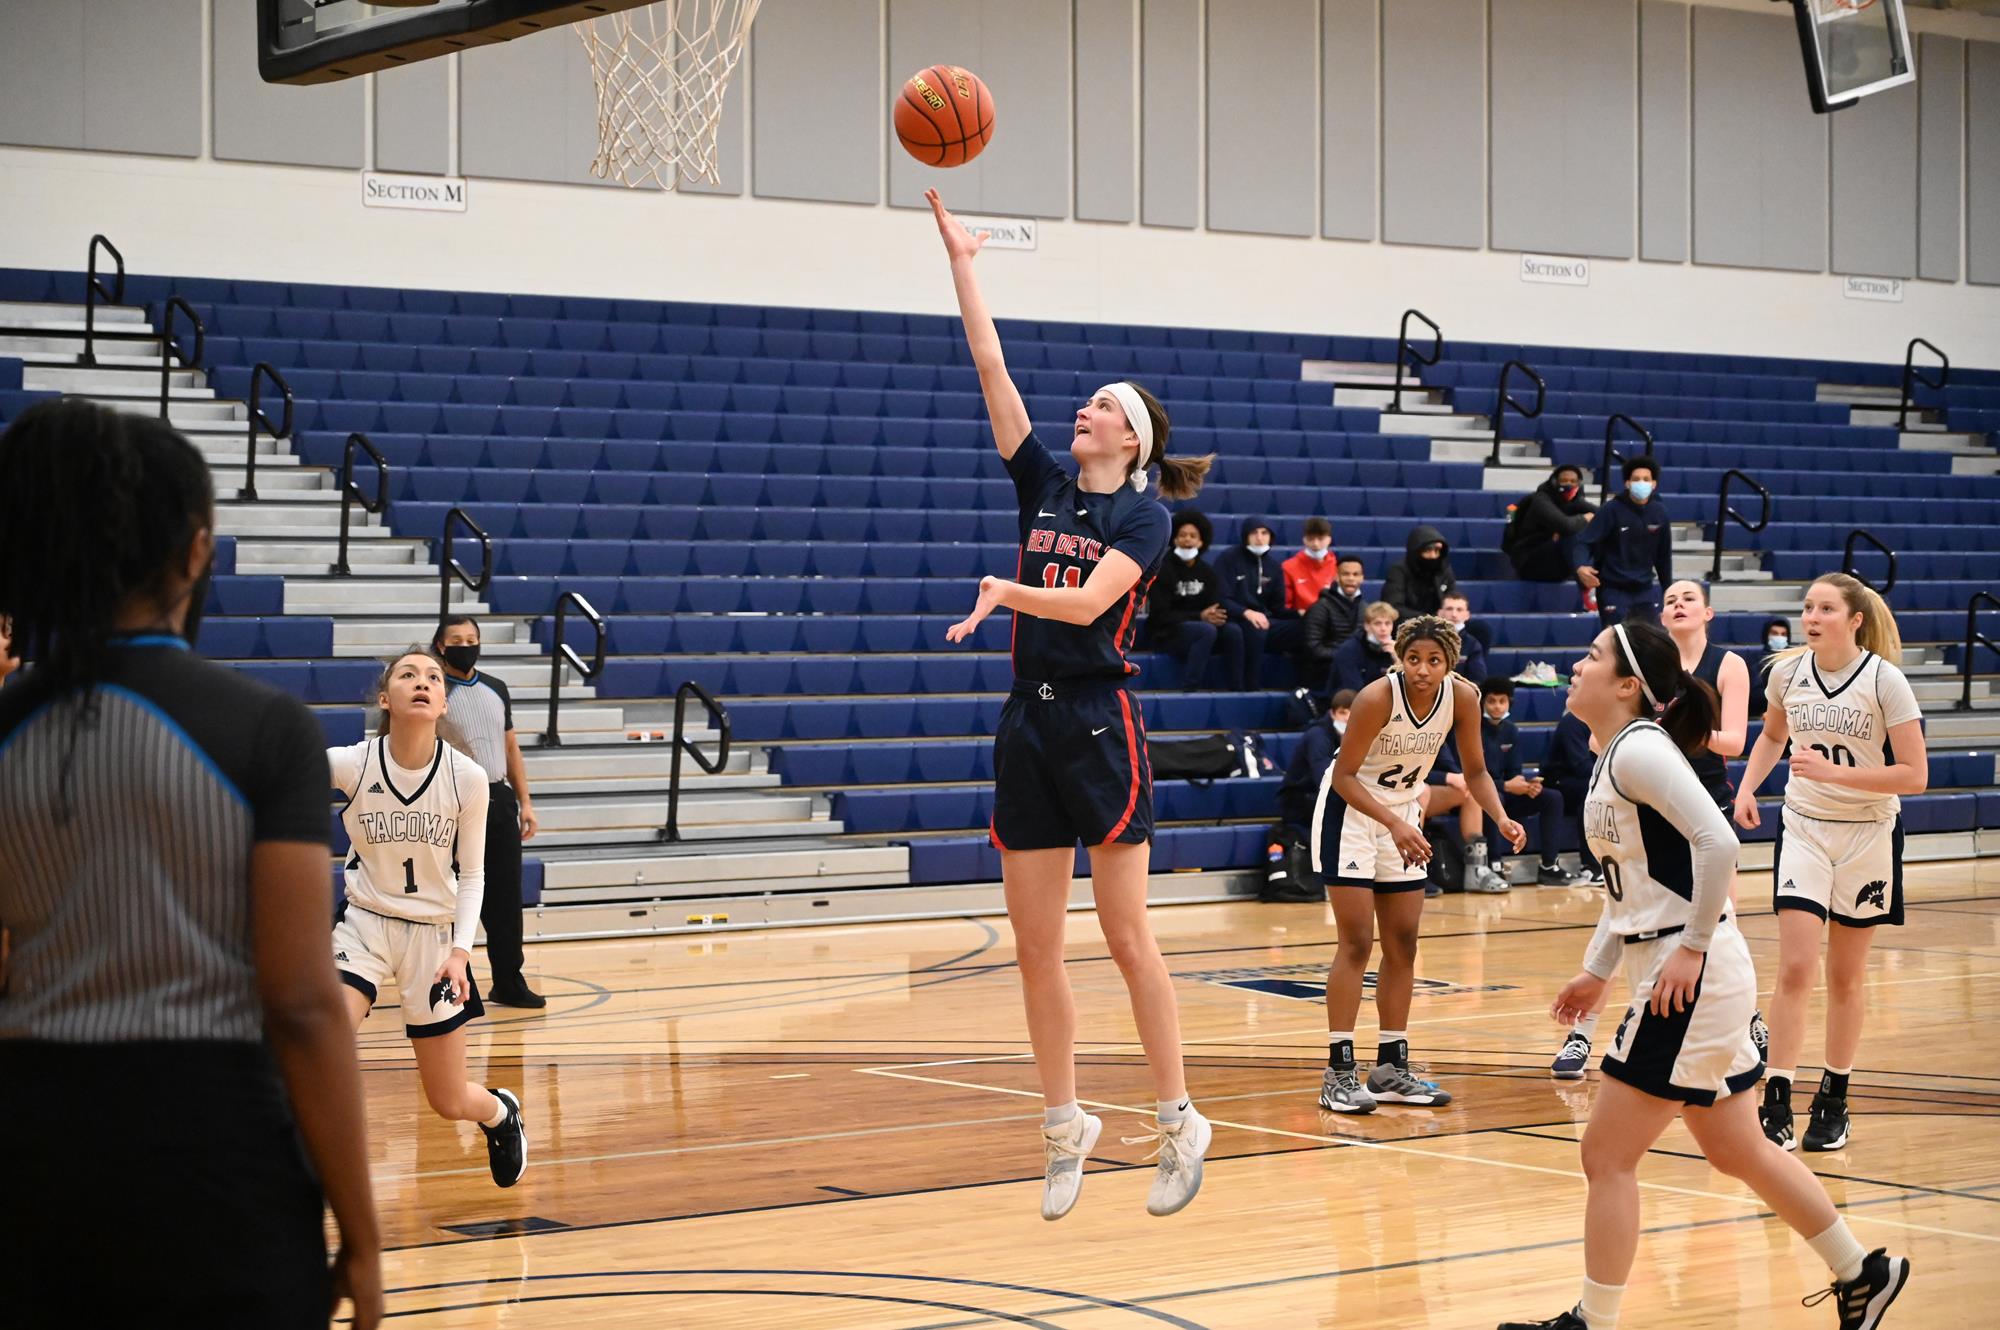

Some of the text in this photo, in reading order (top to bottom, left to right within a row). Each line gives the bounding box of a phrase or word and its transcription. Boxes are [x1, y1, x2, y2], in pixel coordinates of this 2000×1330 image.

[367, 178, 462, 202] SECTION M
[1019, 224, 1031, 242] N
[1524, 259, 1586, 278] SECTION O
[1892, 279, 1900, 296] P
[1027, 528, 1056, 553] RED
[1790, 703, 1874, 741] TACOMA
[1377, 763, 1422, 789] 24
[358, 810, 455, 848] TACOMA
[402, 857, 418, 894] 1
